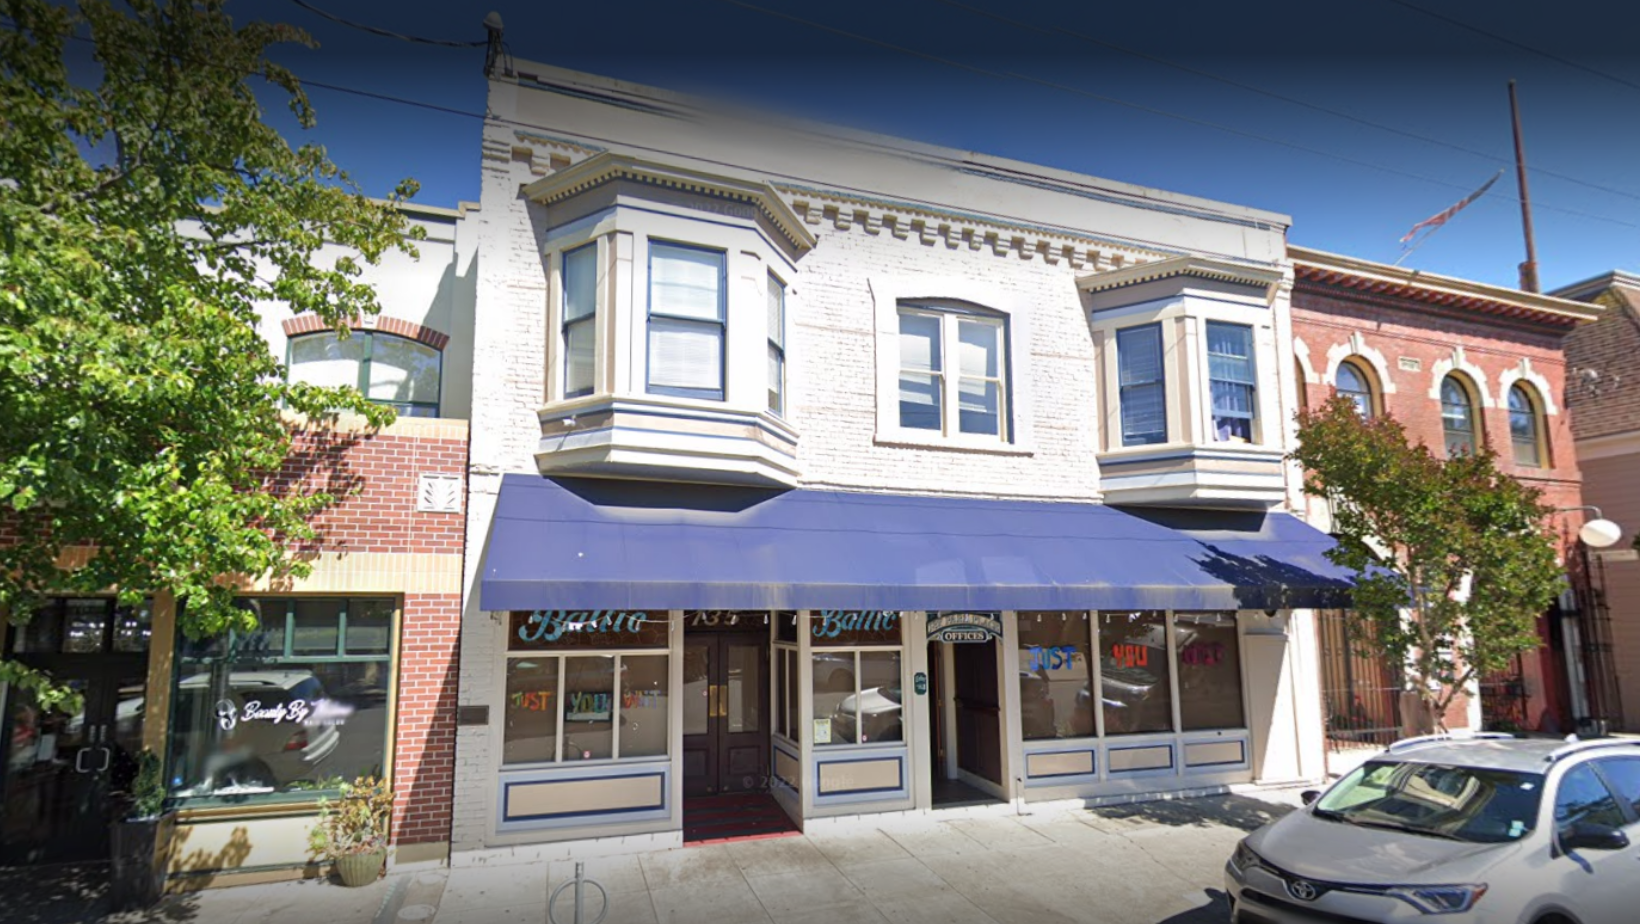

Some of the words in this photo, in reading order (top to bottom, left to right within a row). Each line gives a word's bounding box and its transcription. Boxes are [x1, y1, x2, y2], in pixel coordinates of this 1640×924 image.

[944, 632, 984, 640] OFFICES
[1028, 645, 1077, 671] JUST
[1112, 644, 1148, 668] YOU
[241, 700, 286, 724] Beauty
[285, 698, 309, 722] By
[511, 690, 552, 711] JUST
[570, 691, 609, 713] YOU
